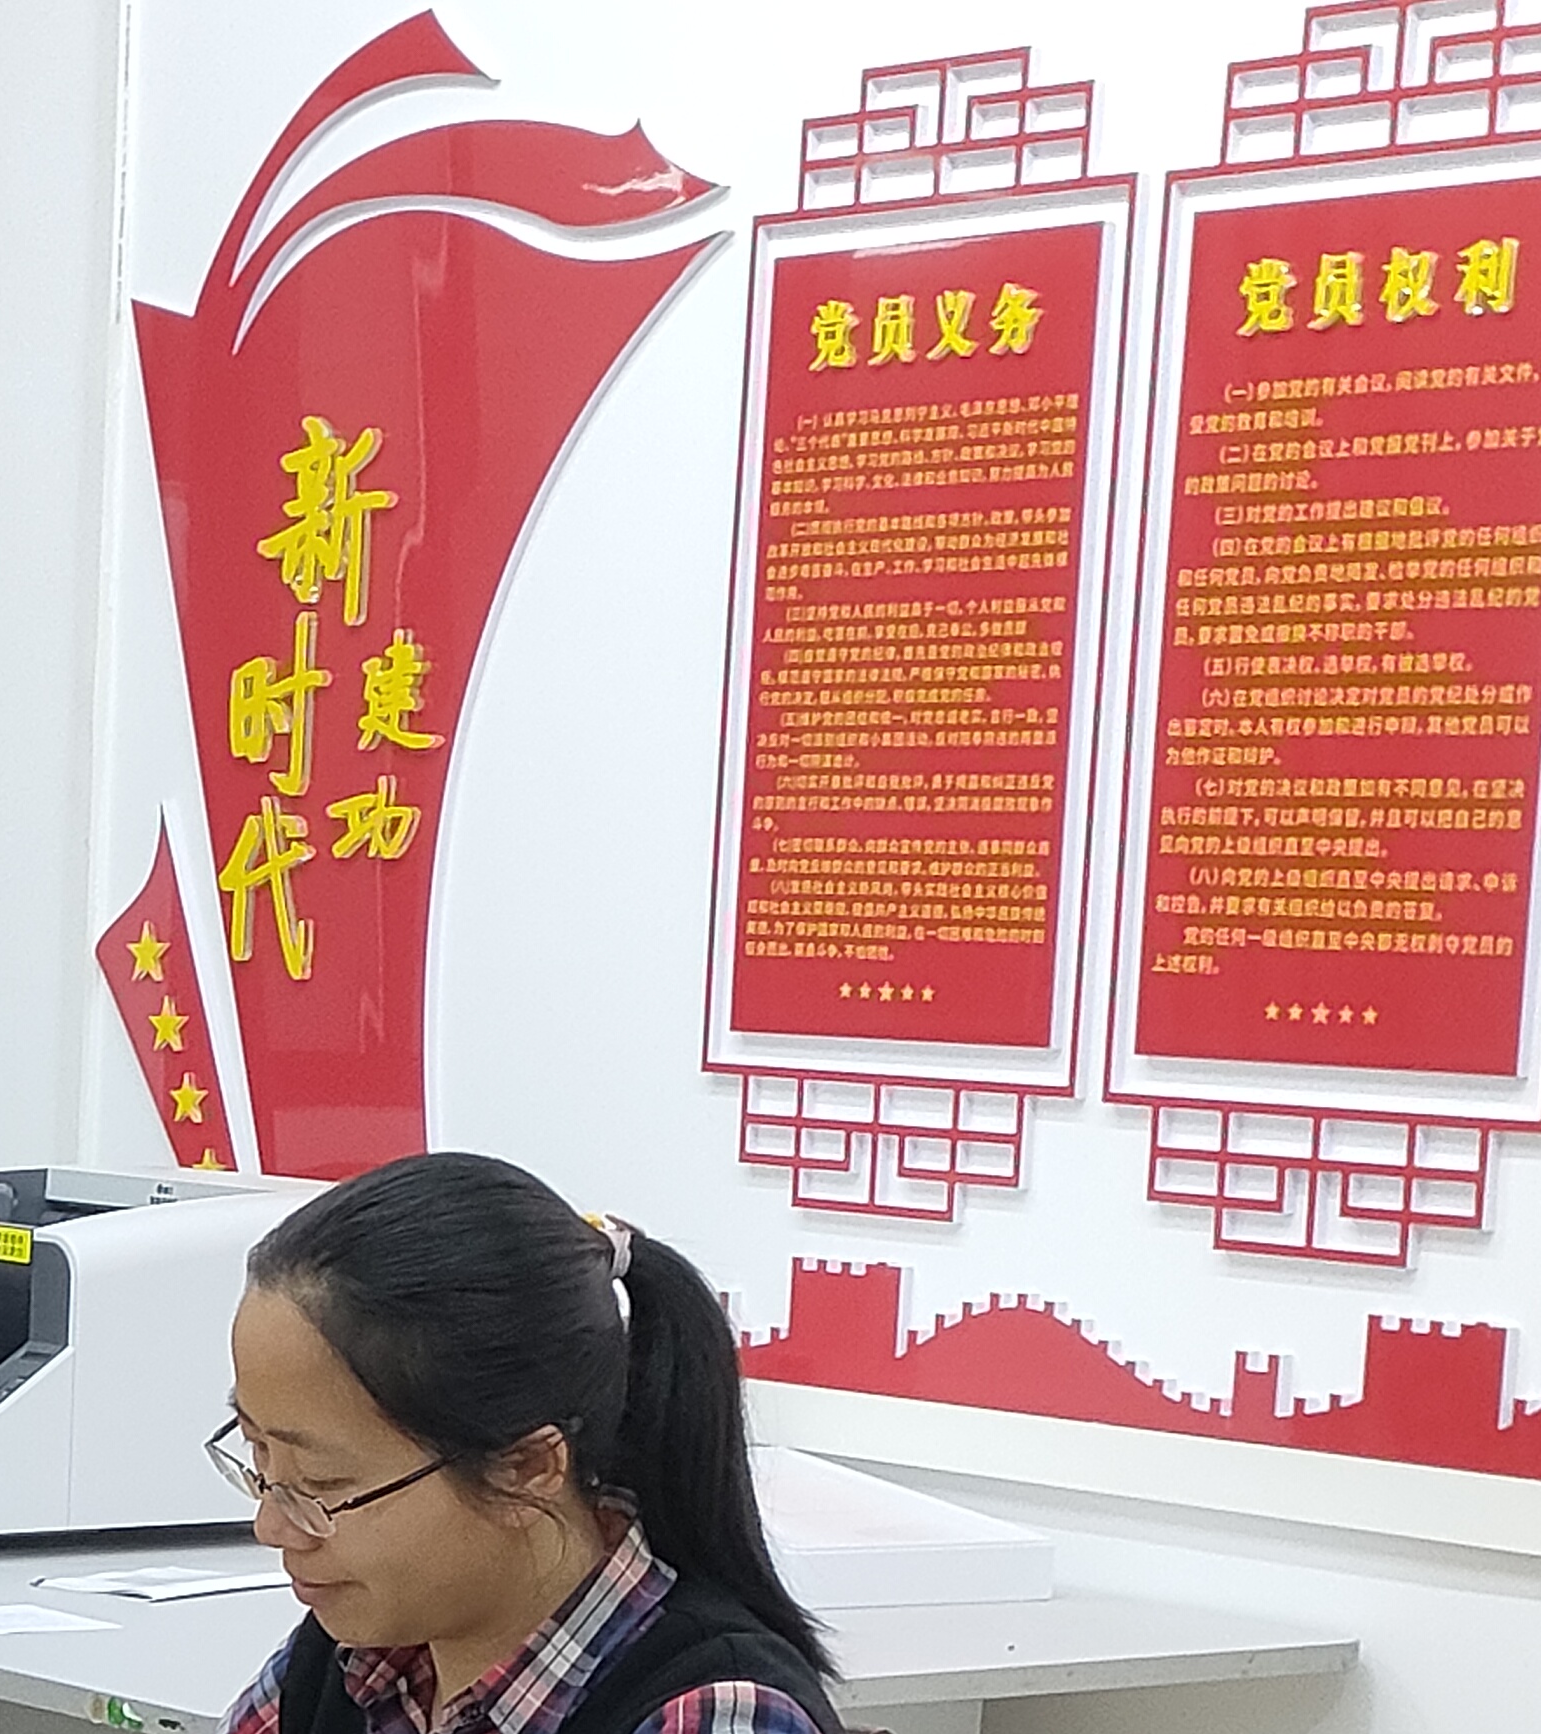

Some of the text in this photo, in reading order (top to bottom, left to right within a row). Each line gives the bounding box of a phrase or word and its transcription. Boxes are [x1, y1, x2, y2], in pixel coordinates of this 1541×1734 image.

[808, 281, 1045, 371] 党员义务
[1236, 237, 1521, 337] 党员权利
[1218, 428, 1541, 465] (二)在党的会议上和党报党刊上,参加关于
[218, 414, 399, 981] 新时代
[327, 628, 445, 860] 建功
